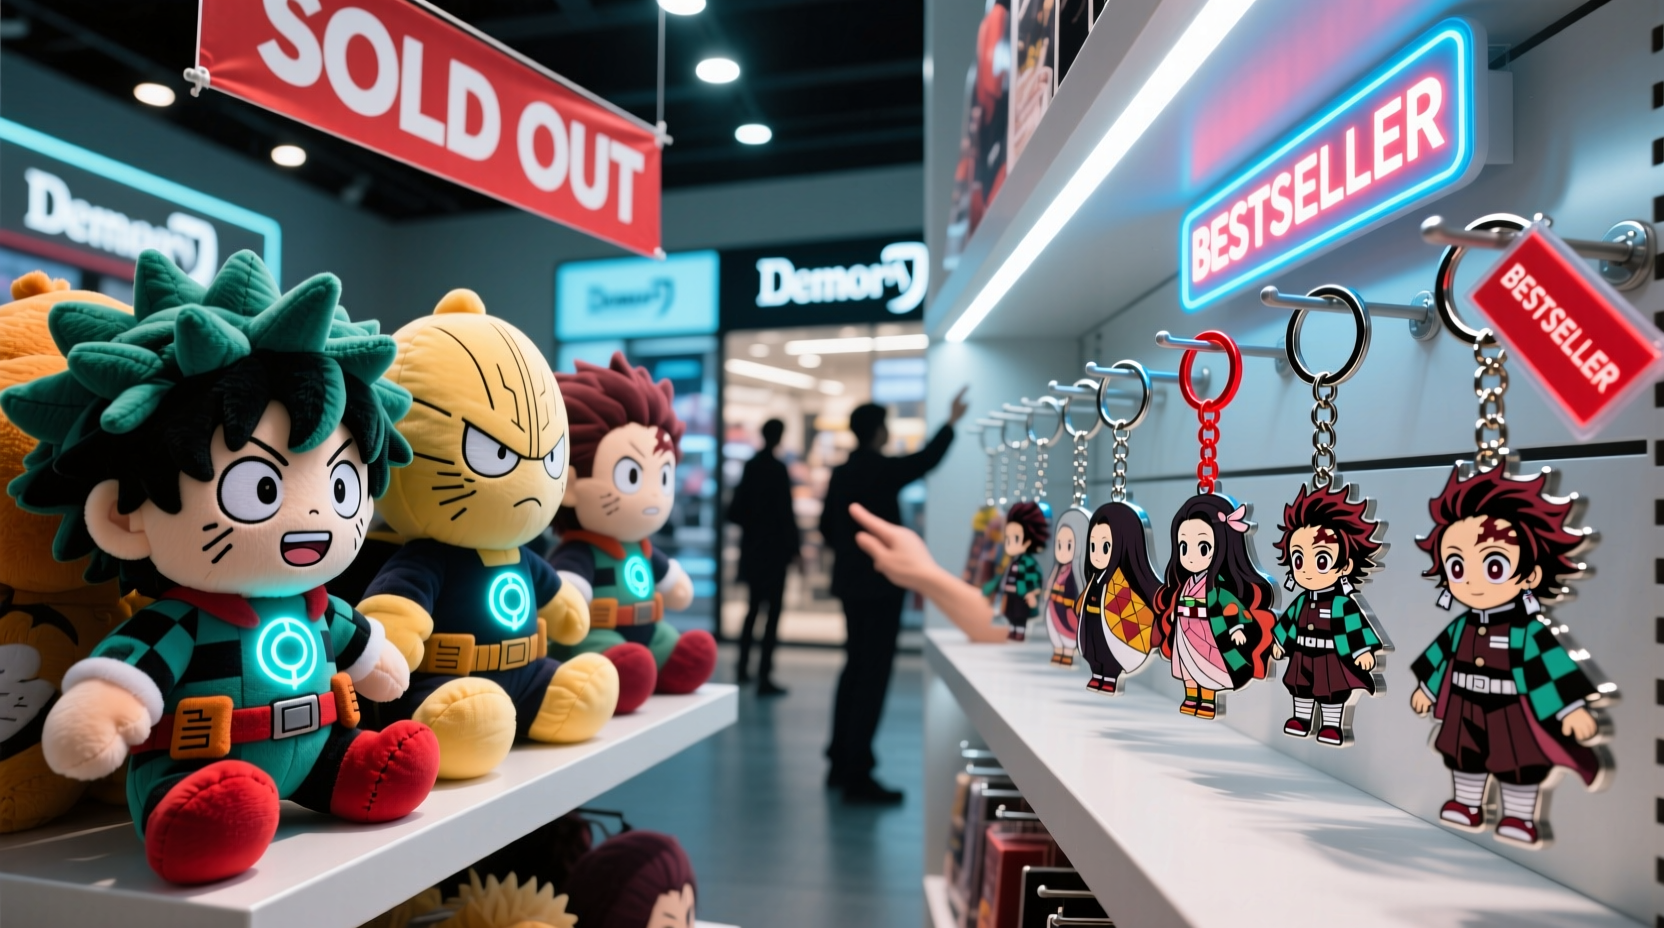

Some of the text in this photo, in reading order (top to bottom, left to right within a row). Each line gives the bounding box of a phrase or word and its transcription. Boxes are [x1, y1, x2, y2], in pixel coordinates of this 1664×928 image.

[256, 0, 645, 225] SOLD OUT
[1191, 77, 1445, 283] BESTSELLER
[1500, 262, 1621, 394] BESTSELLER
